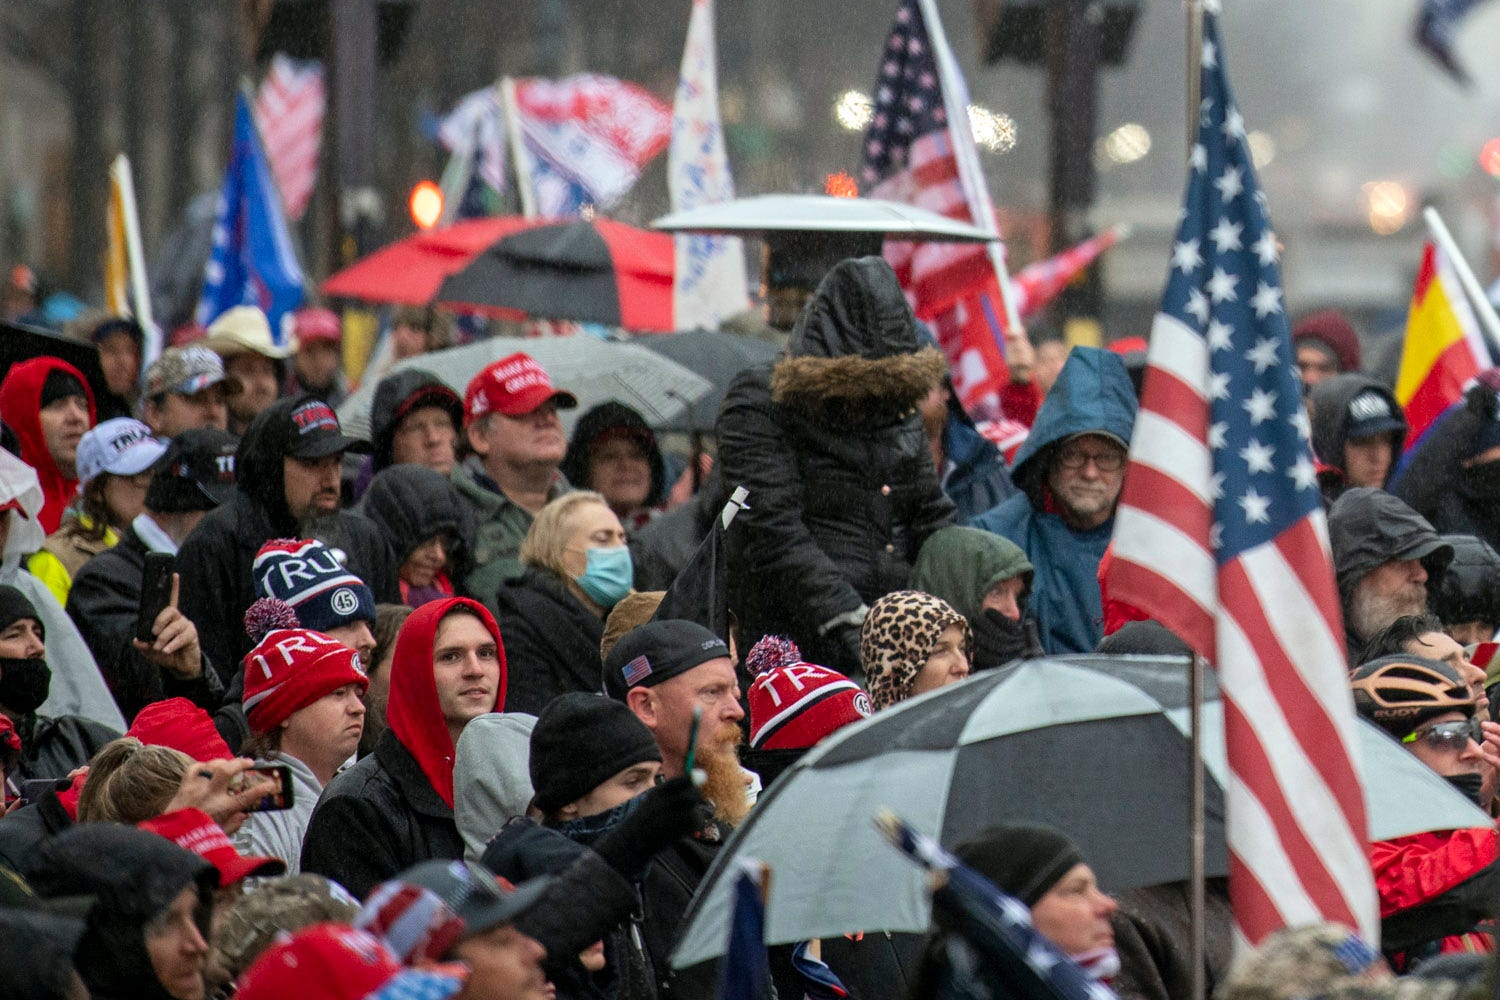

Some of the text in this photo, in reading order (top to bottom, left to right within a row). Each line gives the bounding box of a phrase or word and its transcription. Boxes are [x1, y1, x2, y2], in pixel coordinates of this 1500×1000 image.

[337, 593, 354, 610] 45
[858, 697, 870, 713] 45
[1373, 706, 1421, 718] RUDY
